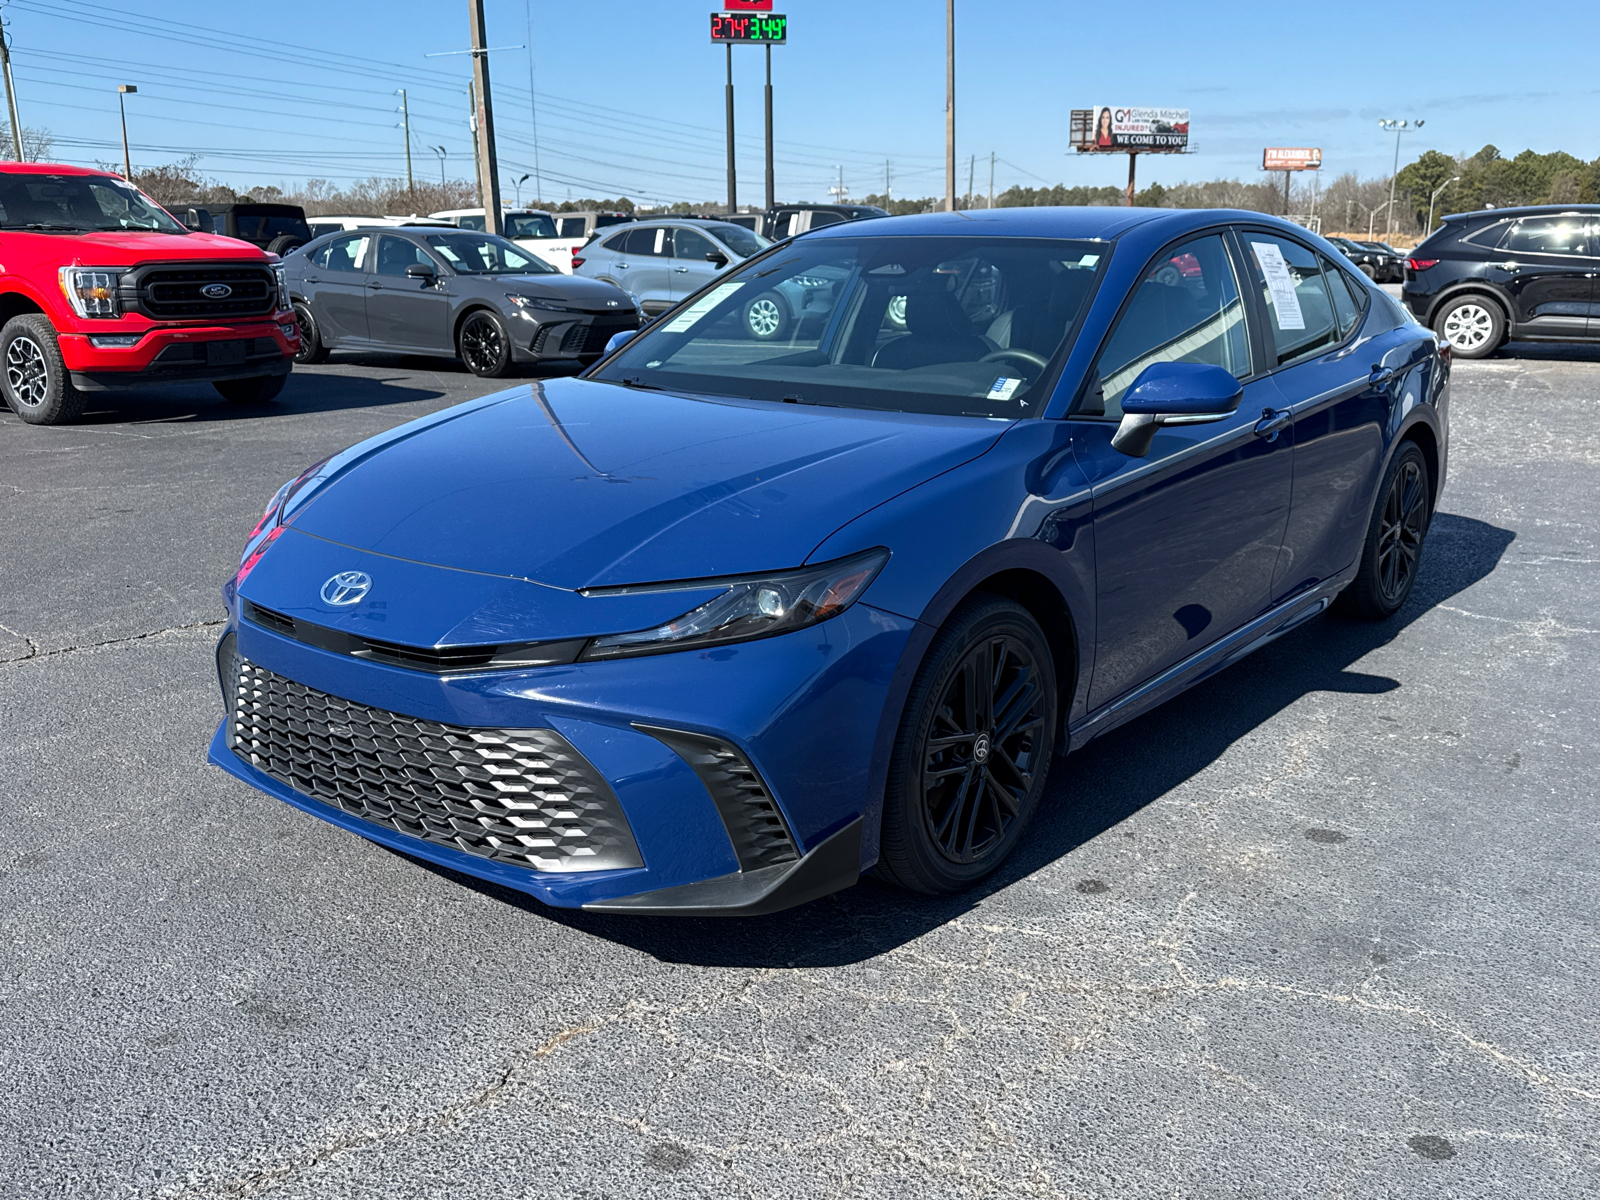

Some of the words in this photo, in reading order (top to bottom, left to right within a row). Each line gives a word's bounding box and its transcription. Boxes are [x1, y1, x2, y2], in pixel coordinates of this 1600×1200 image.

[1115, 109, 1132, 123] GM
[1131, 109, 1158, 119] Glenda
[1160, 110, 1189, 120] Mitchell
[1114, 124, 1149, 132] INJURED?
[1116, 135, 1130, 144] WE
[1130, 135, 1155, 144] COME
[1155, 136, 1168, 145] TO
[1167, 136, 1187, 145] YOU!
